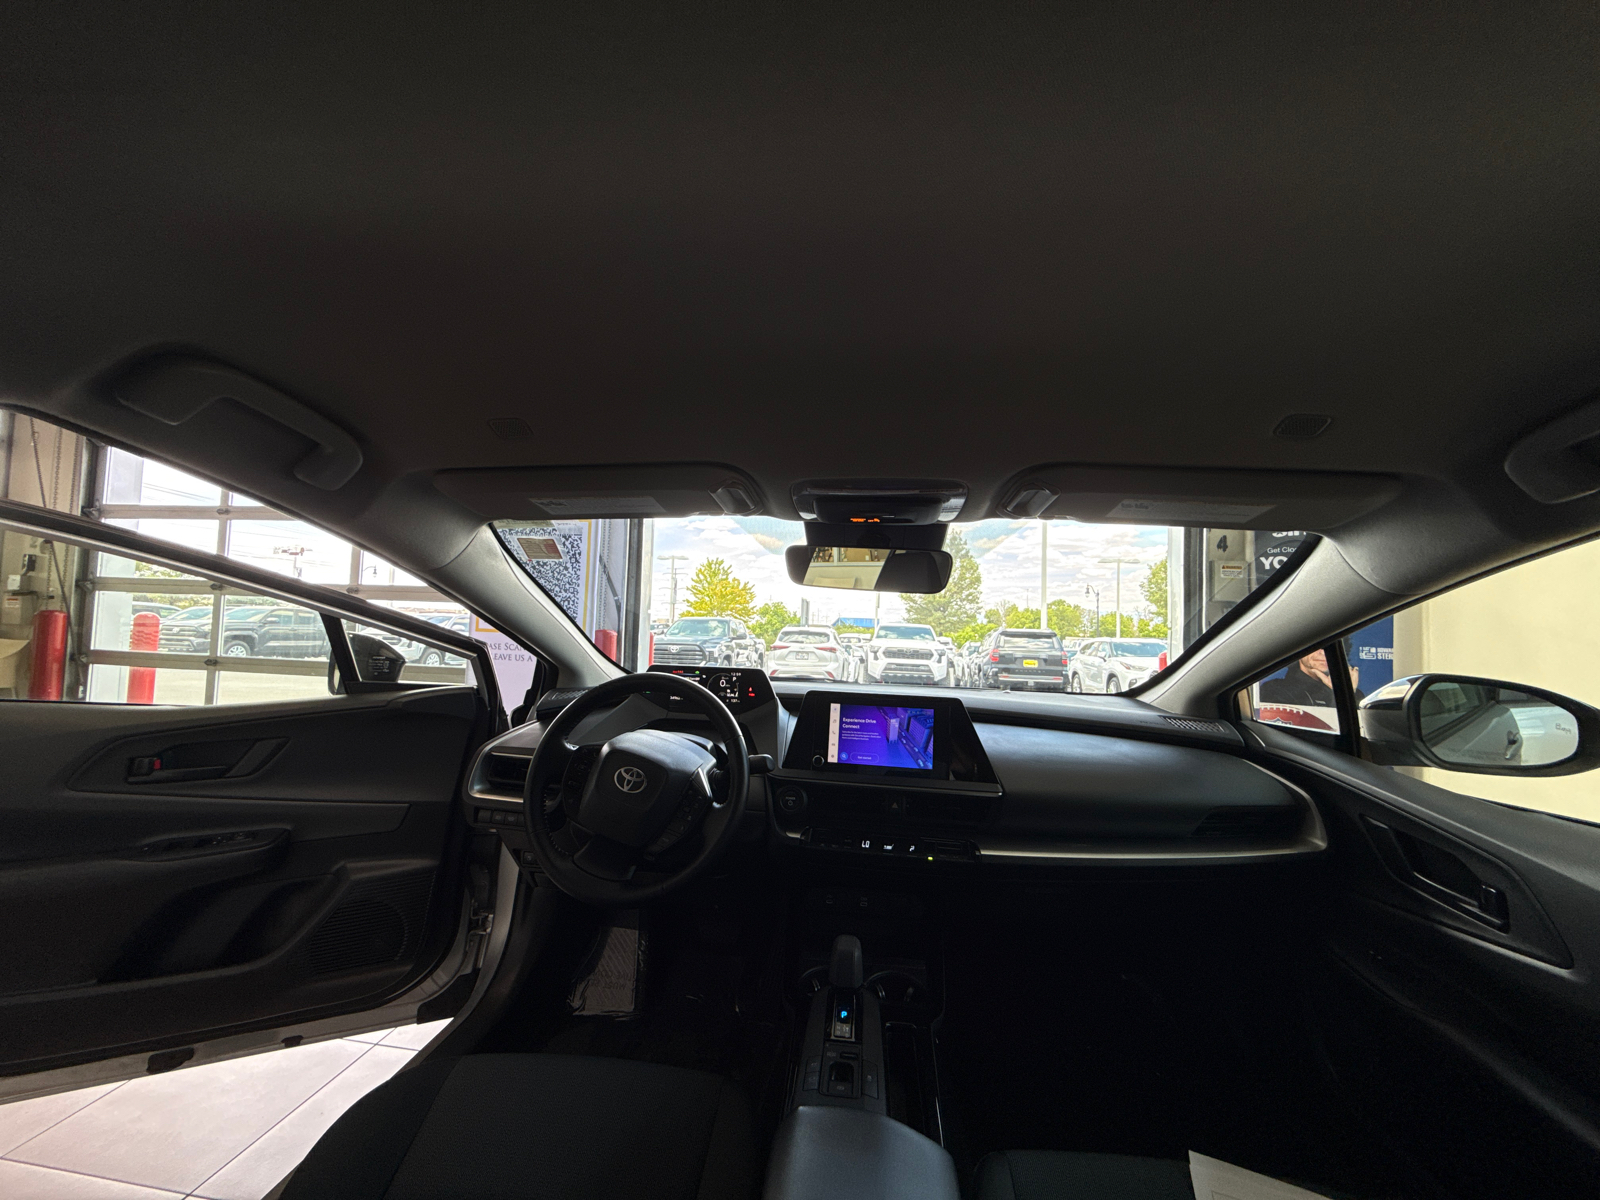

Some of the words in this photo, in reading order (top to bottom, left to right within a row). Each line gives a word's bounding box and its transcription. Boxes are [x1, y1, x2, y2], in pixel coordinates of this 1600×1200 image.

[1217, 535, 1228, 553] 4
[515, 654, 525, 662] US
[841, 1010, 848, 1018] P
